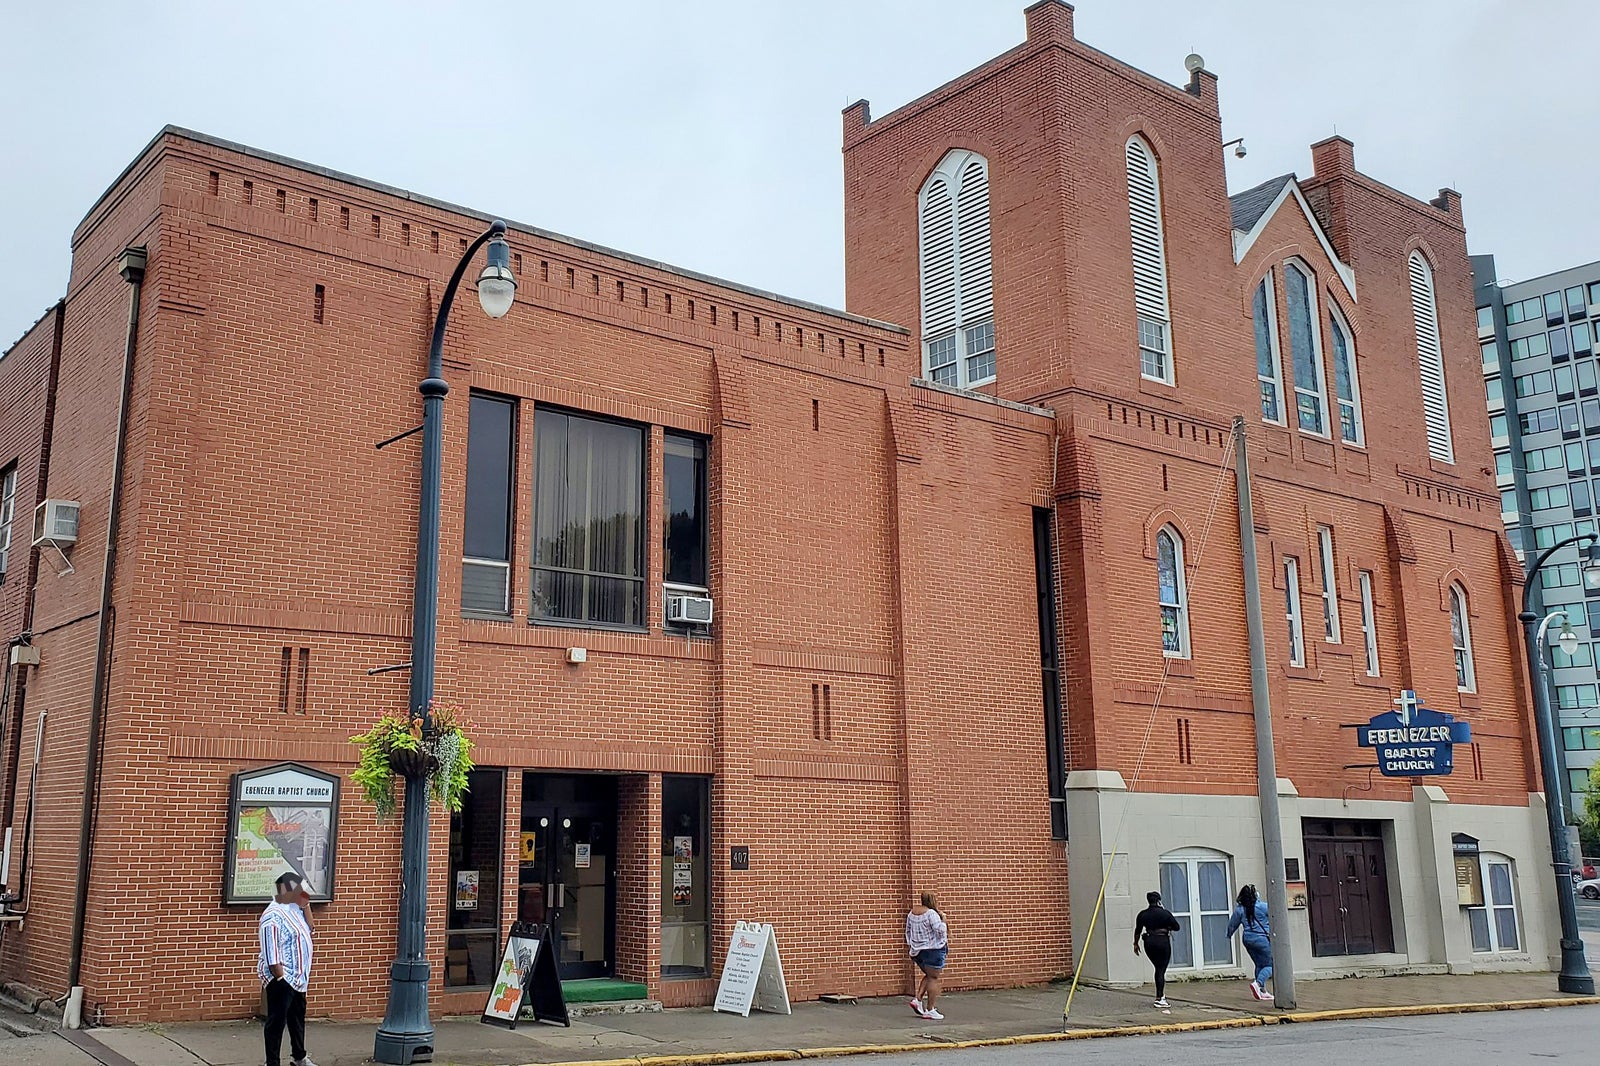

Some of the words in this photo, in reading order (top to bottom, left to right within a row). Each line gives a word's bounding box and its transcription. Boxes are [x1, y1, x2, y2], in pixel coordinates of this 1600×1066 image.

[1368, 726, 1451, 744] EBENEZER
[1384, 747, 1436, 758] BAPTIST
[1386, 760, 1434, 770] CHURCH
[245, 786, 275, 795] EBENEZER
[278, 787, 303, 795] BAPTIST
[306, 787, 329, 796] CHURCH
[733, 852, 747, 863] 407
